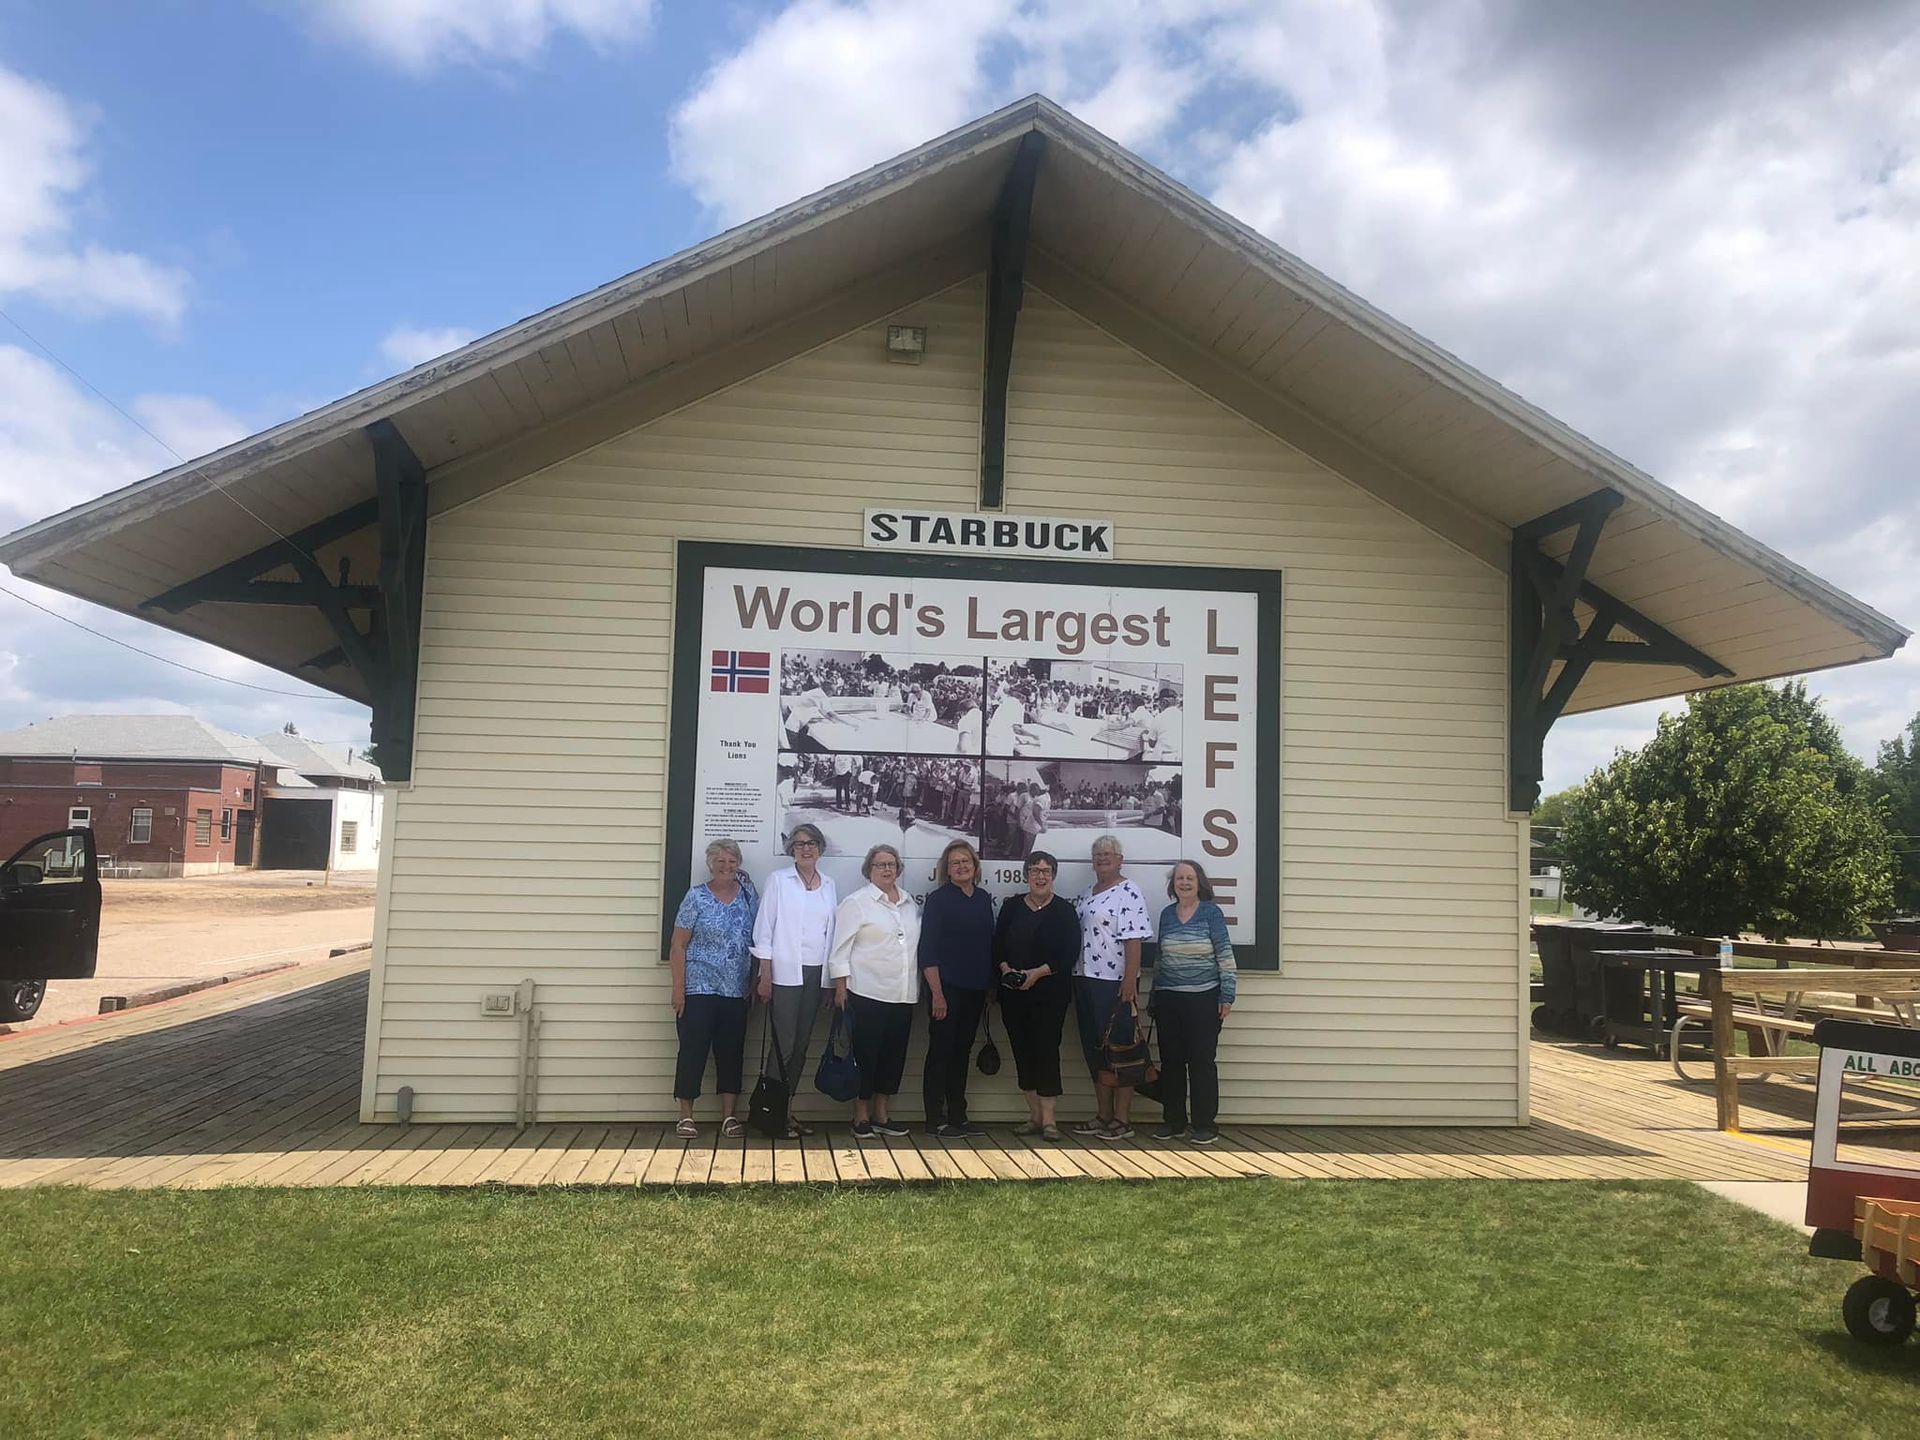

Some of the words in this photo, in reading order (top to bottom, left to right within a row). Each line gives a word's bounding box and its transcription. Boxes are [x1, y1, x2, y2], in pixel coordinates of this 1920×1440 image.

[870, 512, 1110, 553] STARBUCK
[733, 584, 946, 638] World's
[966, 595, 1172, 655] Largest
[720, 740, 741, 748] Thank
[744, 740, 757, 748] You
[1201, 608, 1240, 926] LEFSE
[1843, 1055, 1877, 1073] ALL
